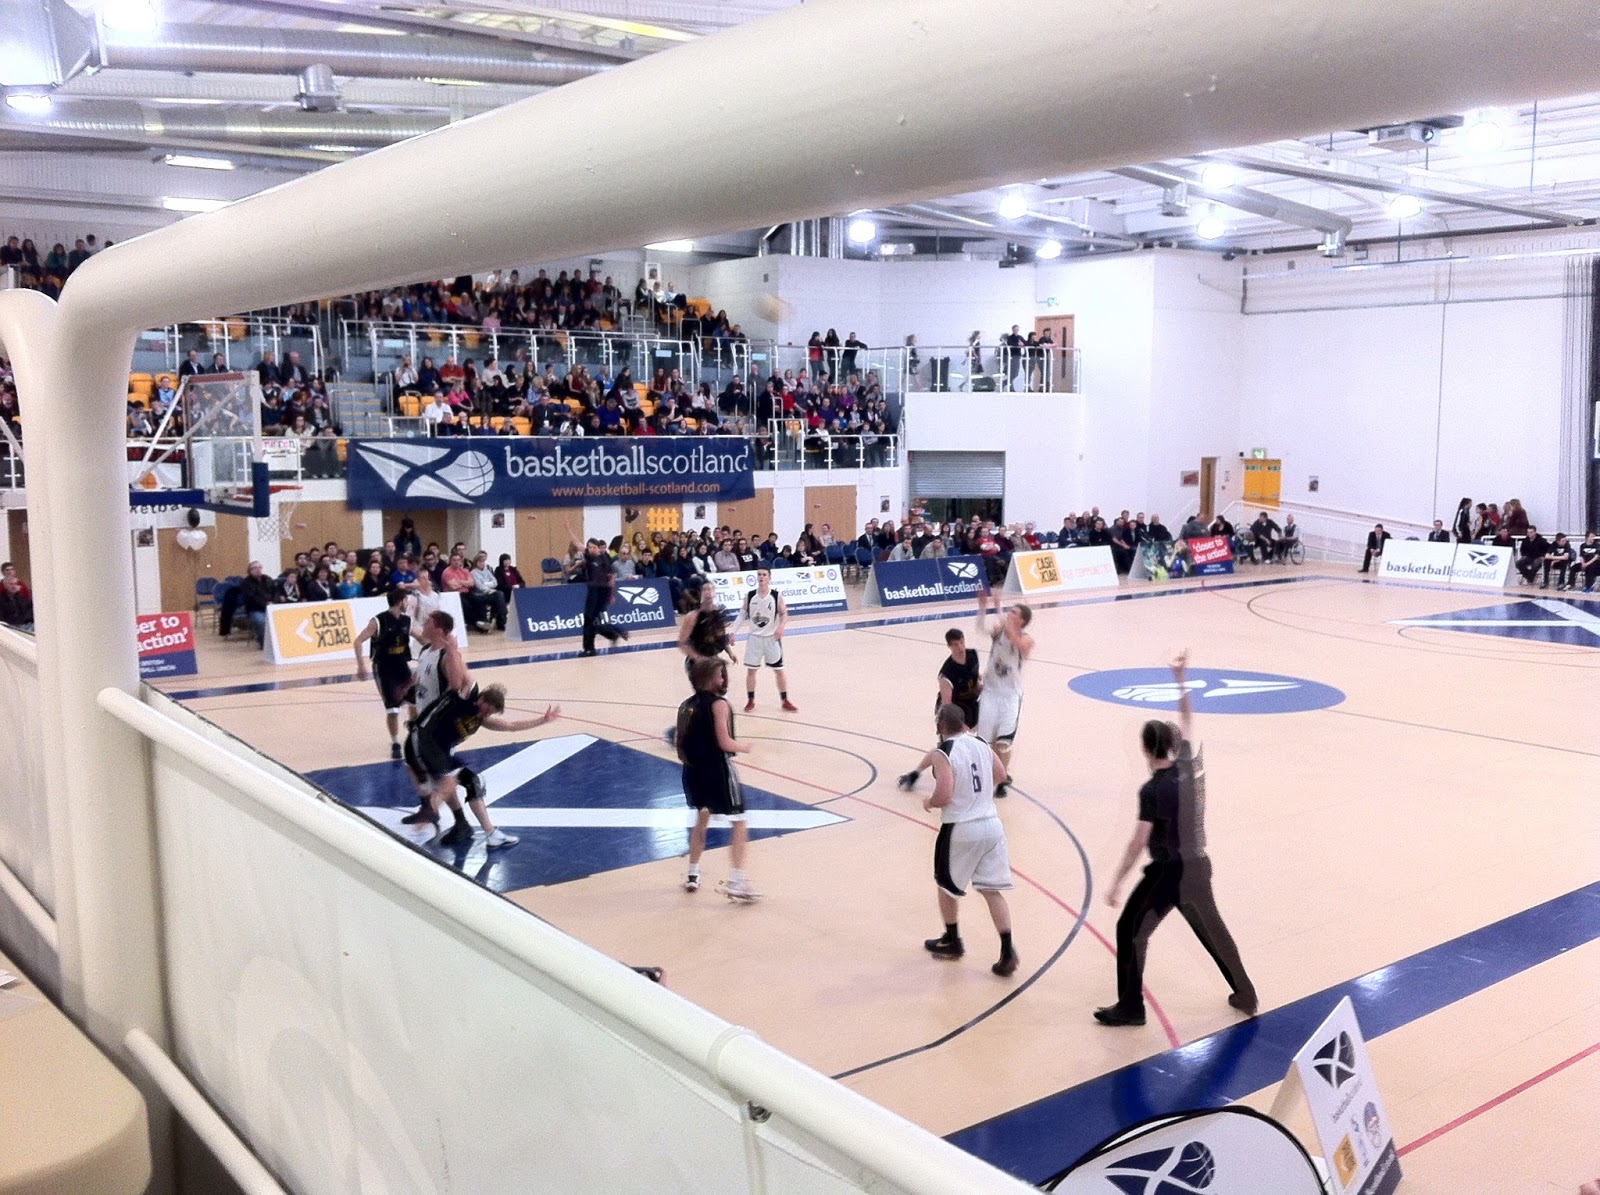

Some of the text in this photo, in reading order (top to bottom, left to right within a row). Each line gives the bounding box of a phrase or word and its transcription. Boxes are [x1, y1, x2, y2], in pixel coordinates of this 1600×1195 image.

[504, 444, 749, 478] basketballscotland
[551, 481, 721, 497] www.basketball-scotland.com
[1386, 561, 1498, 581] basketballscotland
[715, 591, 735, 602] The
[810, 584, 840, 595] Centre
[883, 579, 984, 600] basketballscotland
[136, 616, 180, 634] er to
[311, 608, 348, 630] CASH
[527, 606, 665, 632] basketllscotland
[970, 762, 982, 793] 6
